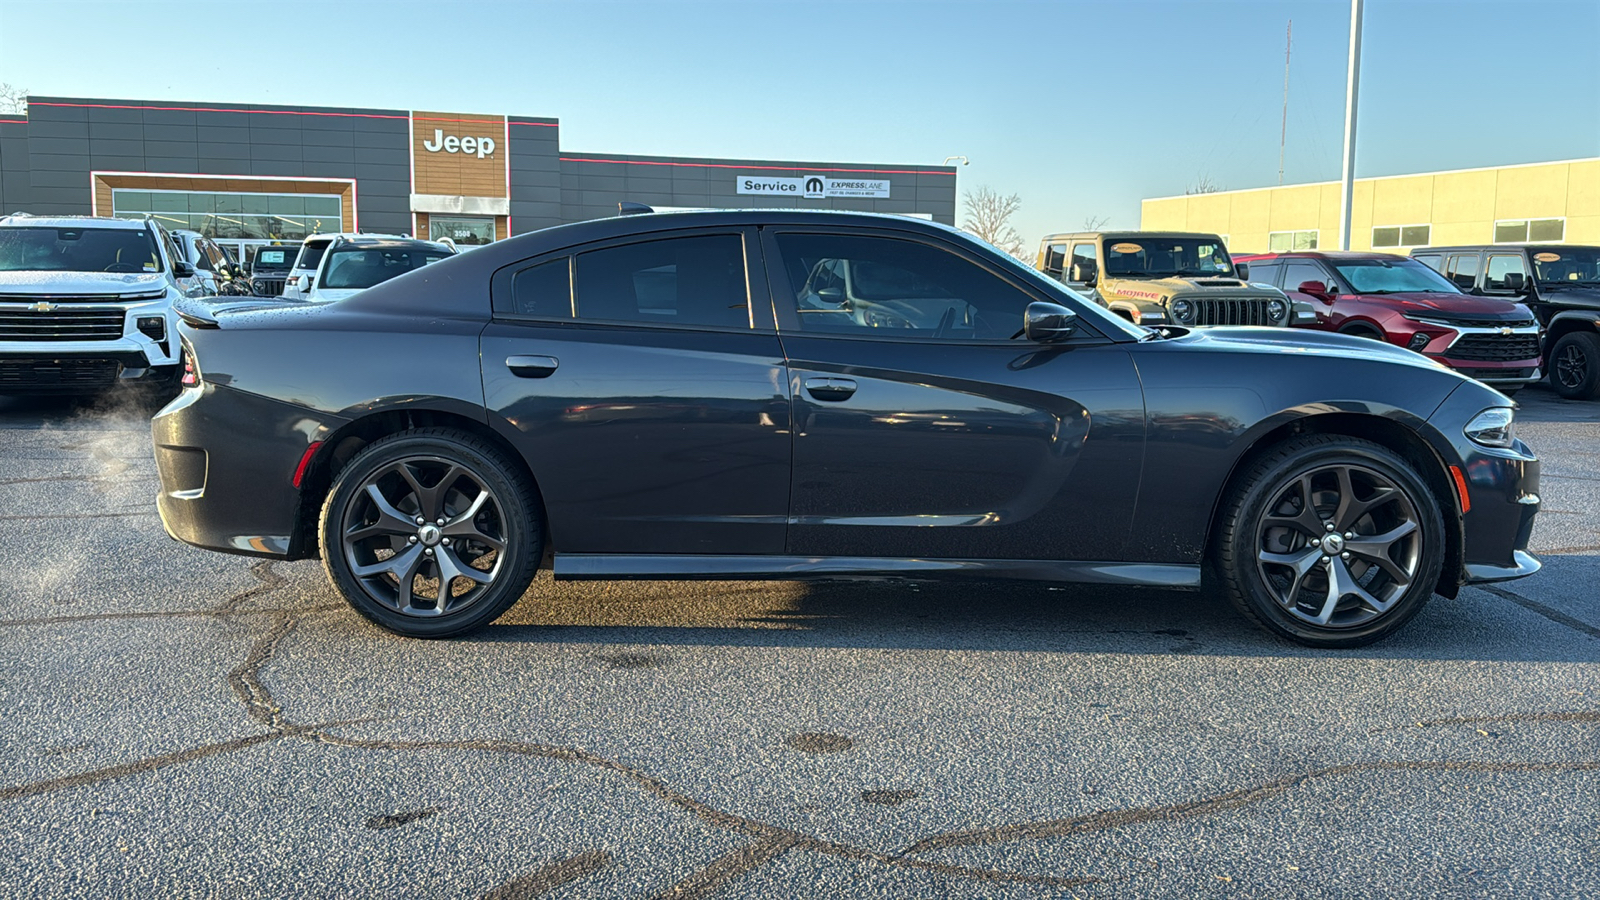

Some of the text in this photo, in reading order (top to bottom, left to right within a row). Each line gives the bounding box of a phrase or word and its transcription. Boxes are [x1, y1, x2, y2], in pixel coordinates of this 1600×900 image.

[423, 129, 495, 159] Jeep
[744, 180, 797, 192] Service
[454, 230, 471, 238] 3508
[1116, 289, 1160, 299] MOJAVE
